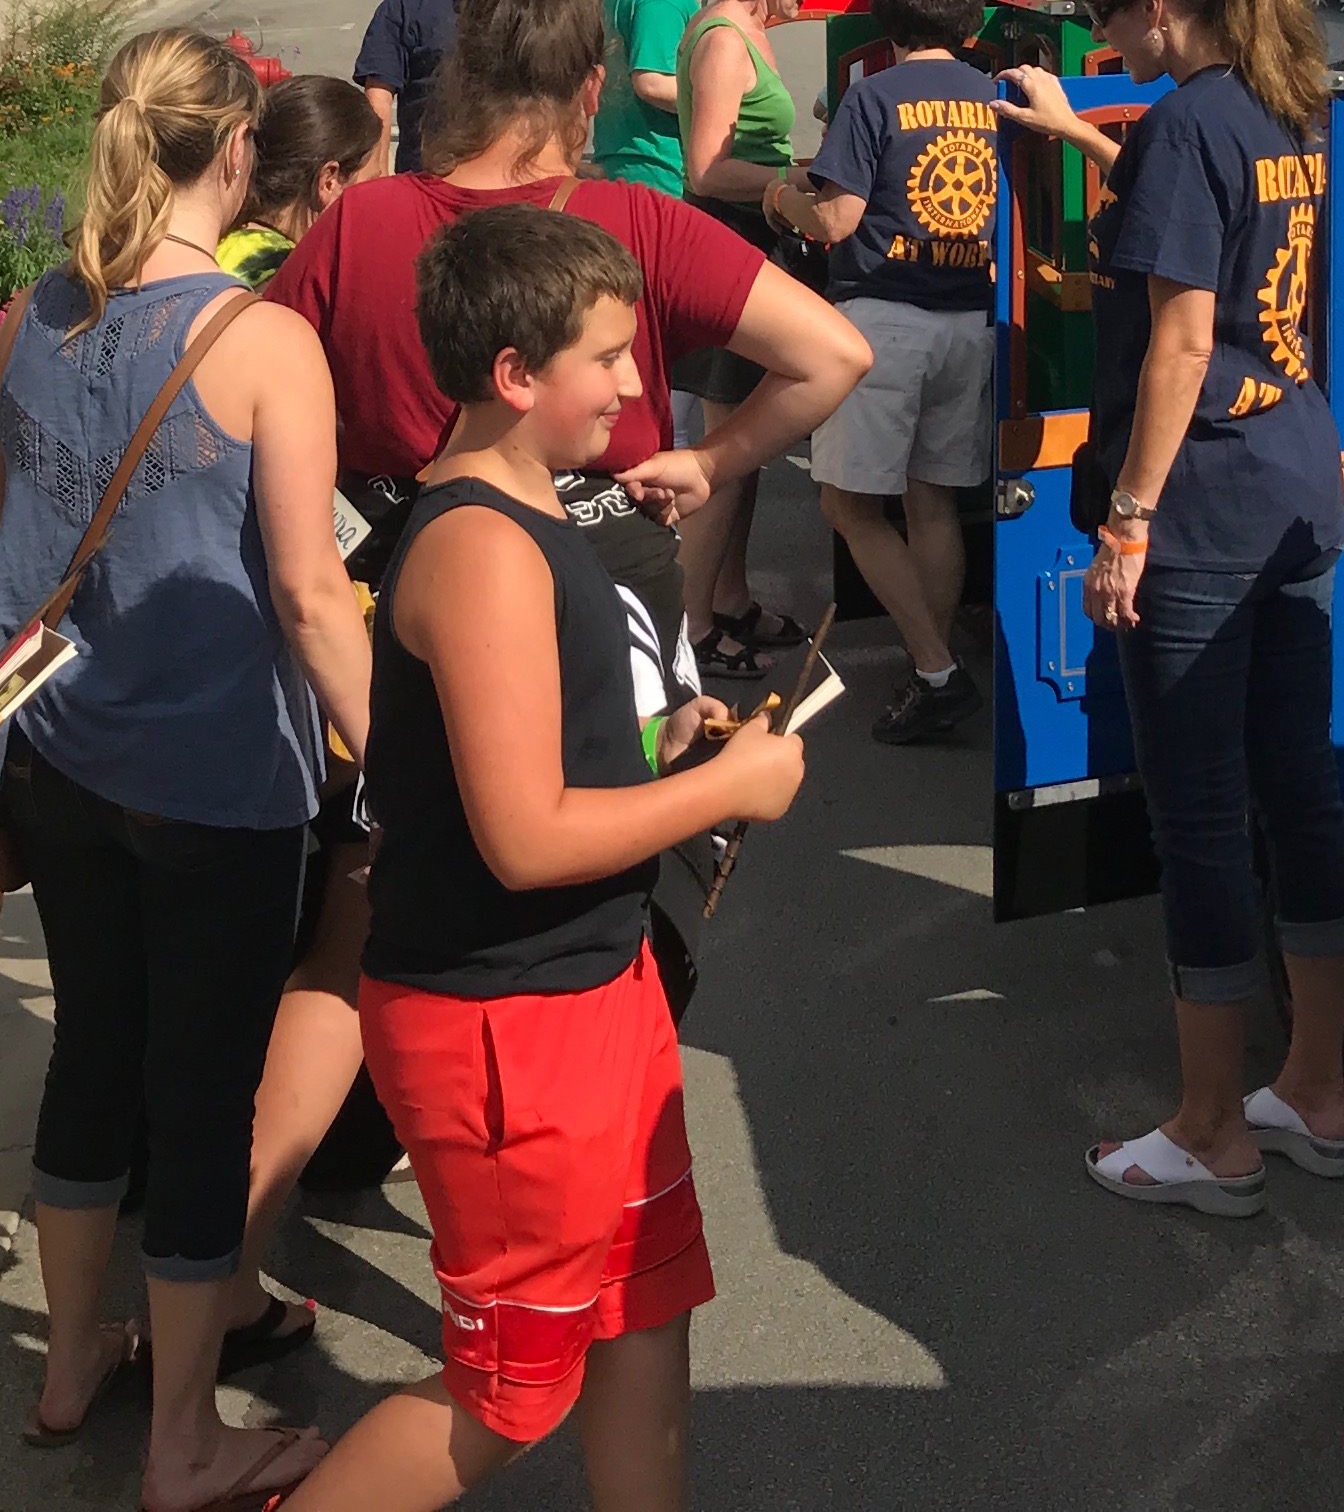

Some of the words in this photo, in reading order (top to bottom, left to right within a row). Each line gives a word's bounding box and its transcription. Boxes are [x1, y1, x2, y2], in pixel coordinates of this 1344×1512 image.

[896, 100, 998, 131] ROTARIA
[943, 141, 980, 157] ROTARY
[922, 198, 984, 230] INTERNATIONAL
[886, 234, 924, 262] AT
